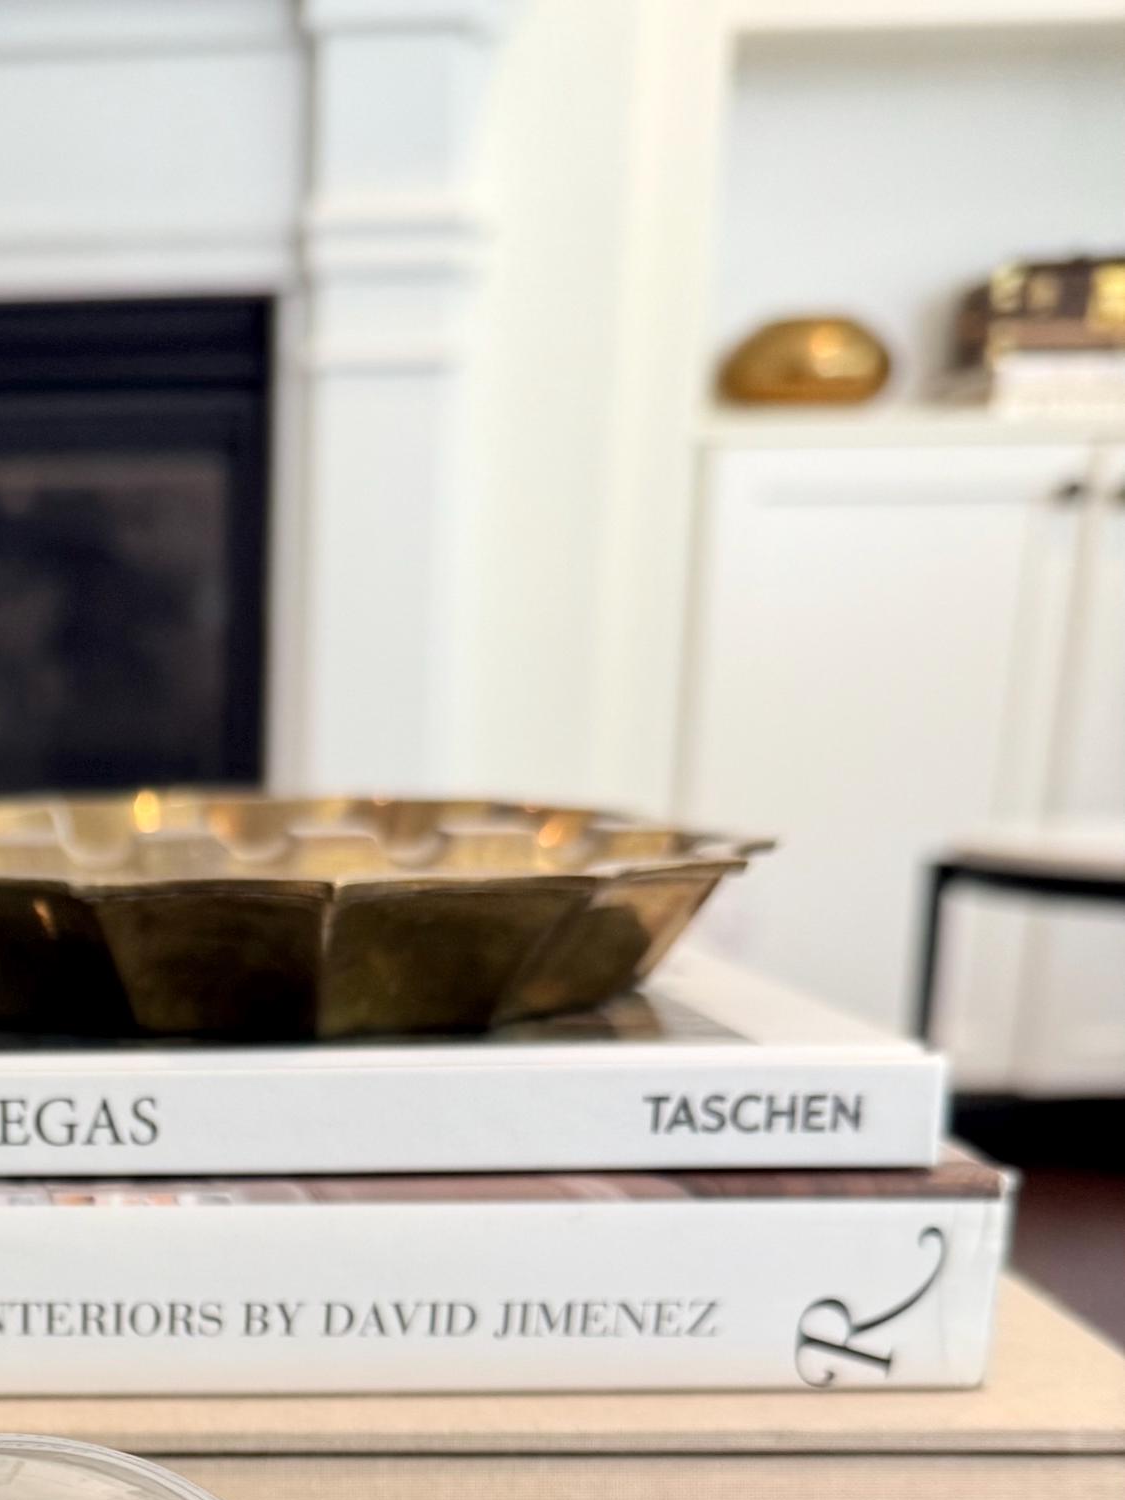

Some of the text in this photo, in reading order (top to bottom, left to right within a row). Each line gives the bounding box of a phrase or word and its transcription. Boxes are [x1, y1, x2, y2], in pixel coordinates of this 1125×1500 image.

[643, 1093, 865, 1134] TASCHEN
[241, 1301, 307, 1337] BY
[319, 1302, 476, 1338] DAVID
[493, 1301, 720, 1338] JIMENEZ
